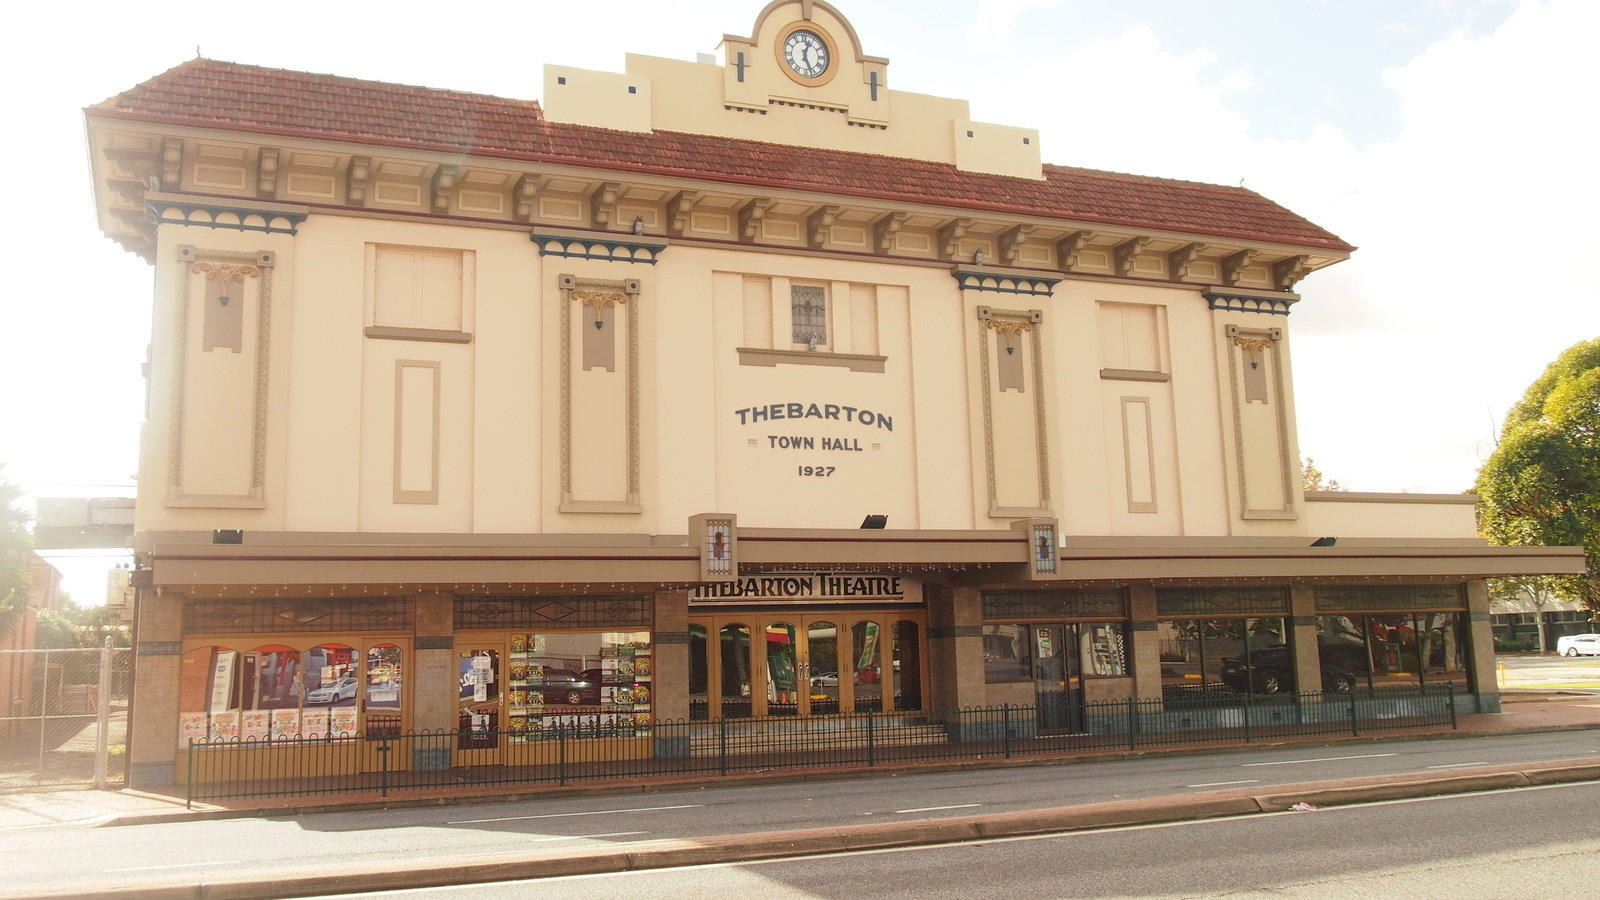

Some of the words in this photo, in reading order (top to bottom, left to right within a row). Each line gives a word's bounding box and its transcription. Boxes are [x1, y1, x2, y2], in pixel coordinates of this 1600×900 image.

[735, 402, 893, 432] THEBARTON
[767, 435, 815, 450] TOWN
[821, 437, 863, 452] HALL
[798, 465, 836, 477] 1927
[815, 572, 904, 596] THEATRE
